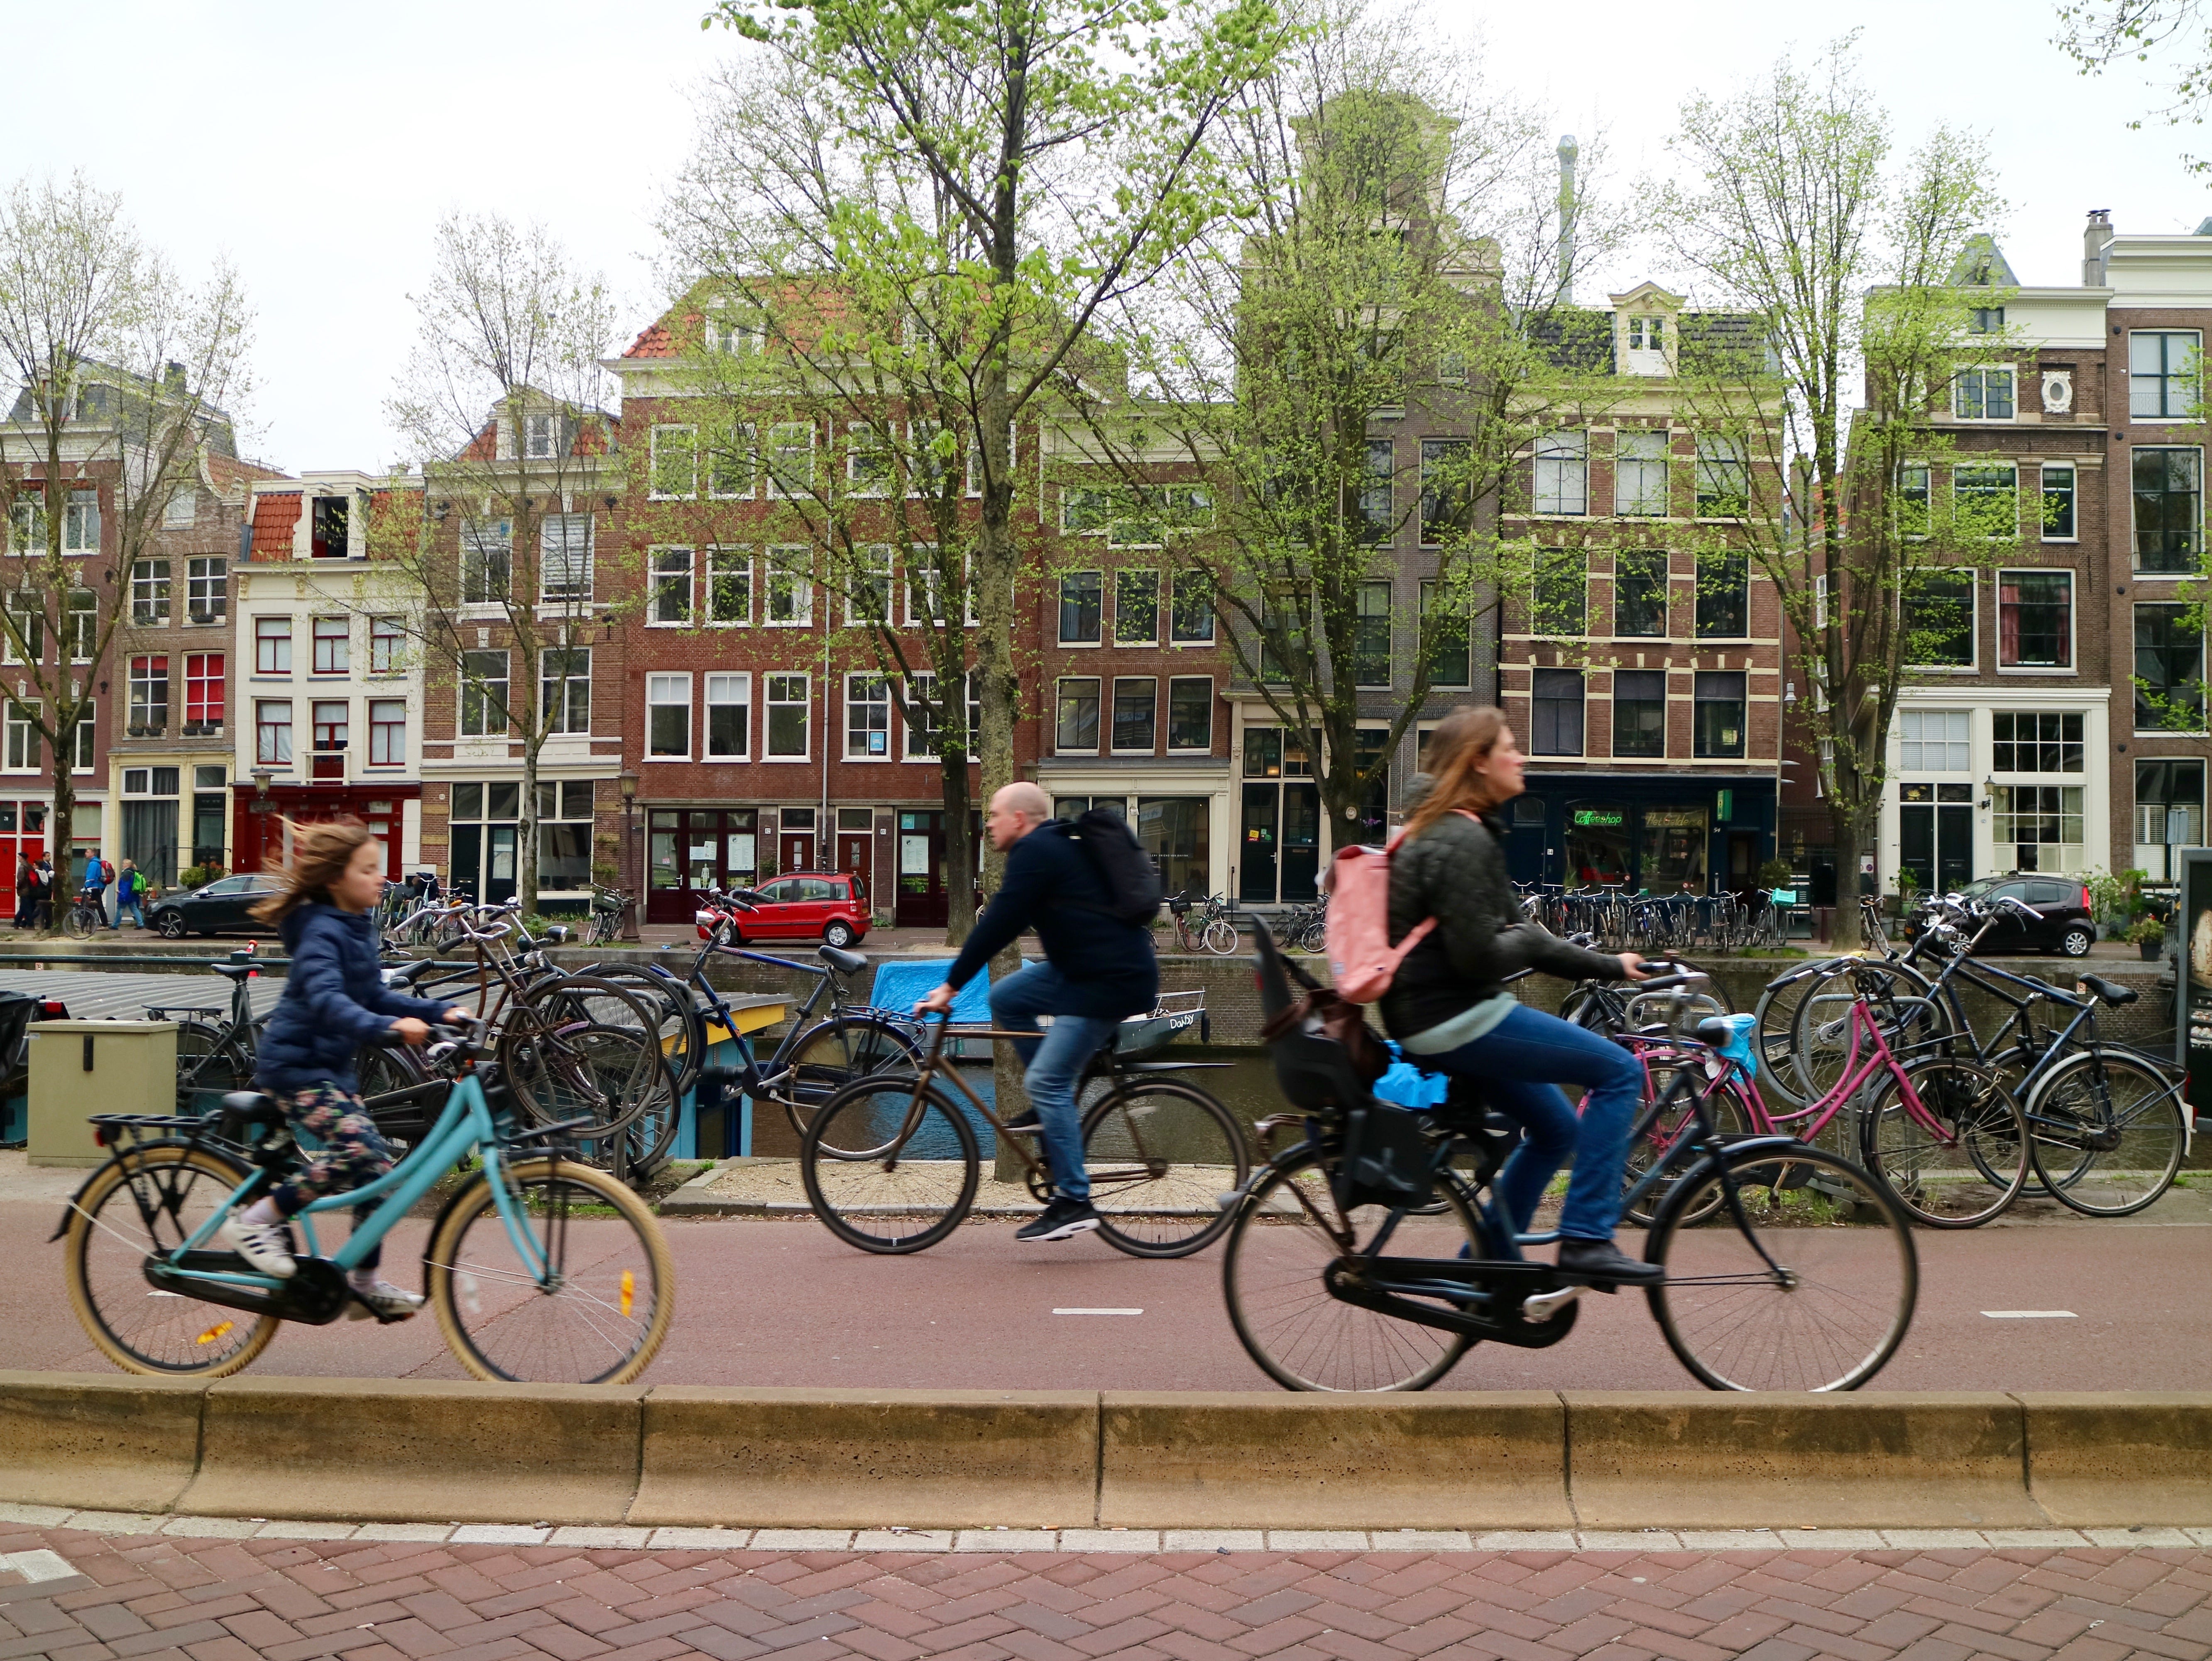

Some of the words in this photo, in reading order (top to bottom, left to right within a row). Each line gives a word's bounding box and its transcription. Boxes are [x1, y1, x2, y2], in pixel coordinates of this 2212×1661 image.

[1575, 811, 1622, 825] Coffeeshop
[1647, 814, 1662, 826] Het
[1170, 1014, 1194, 1029] Daisy
[1964, 1019, 1980, 1051] BATAVUS
